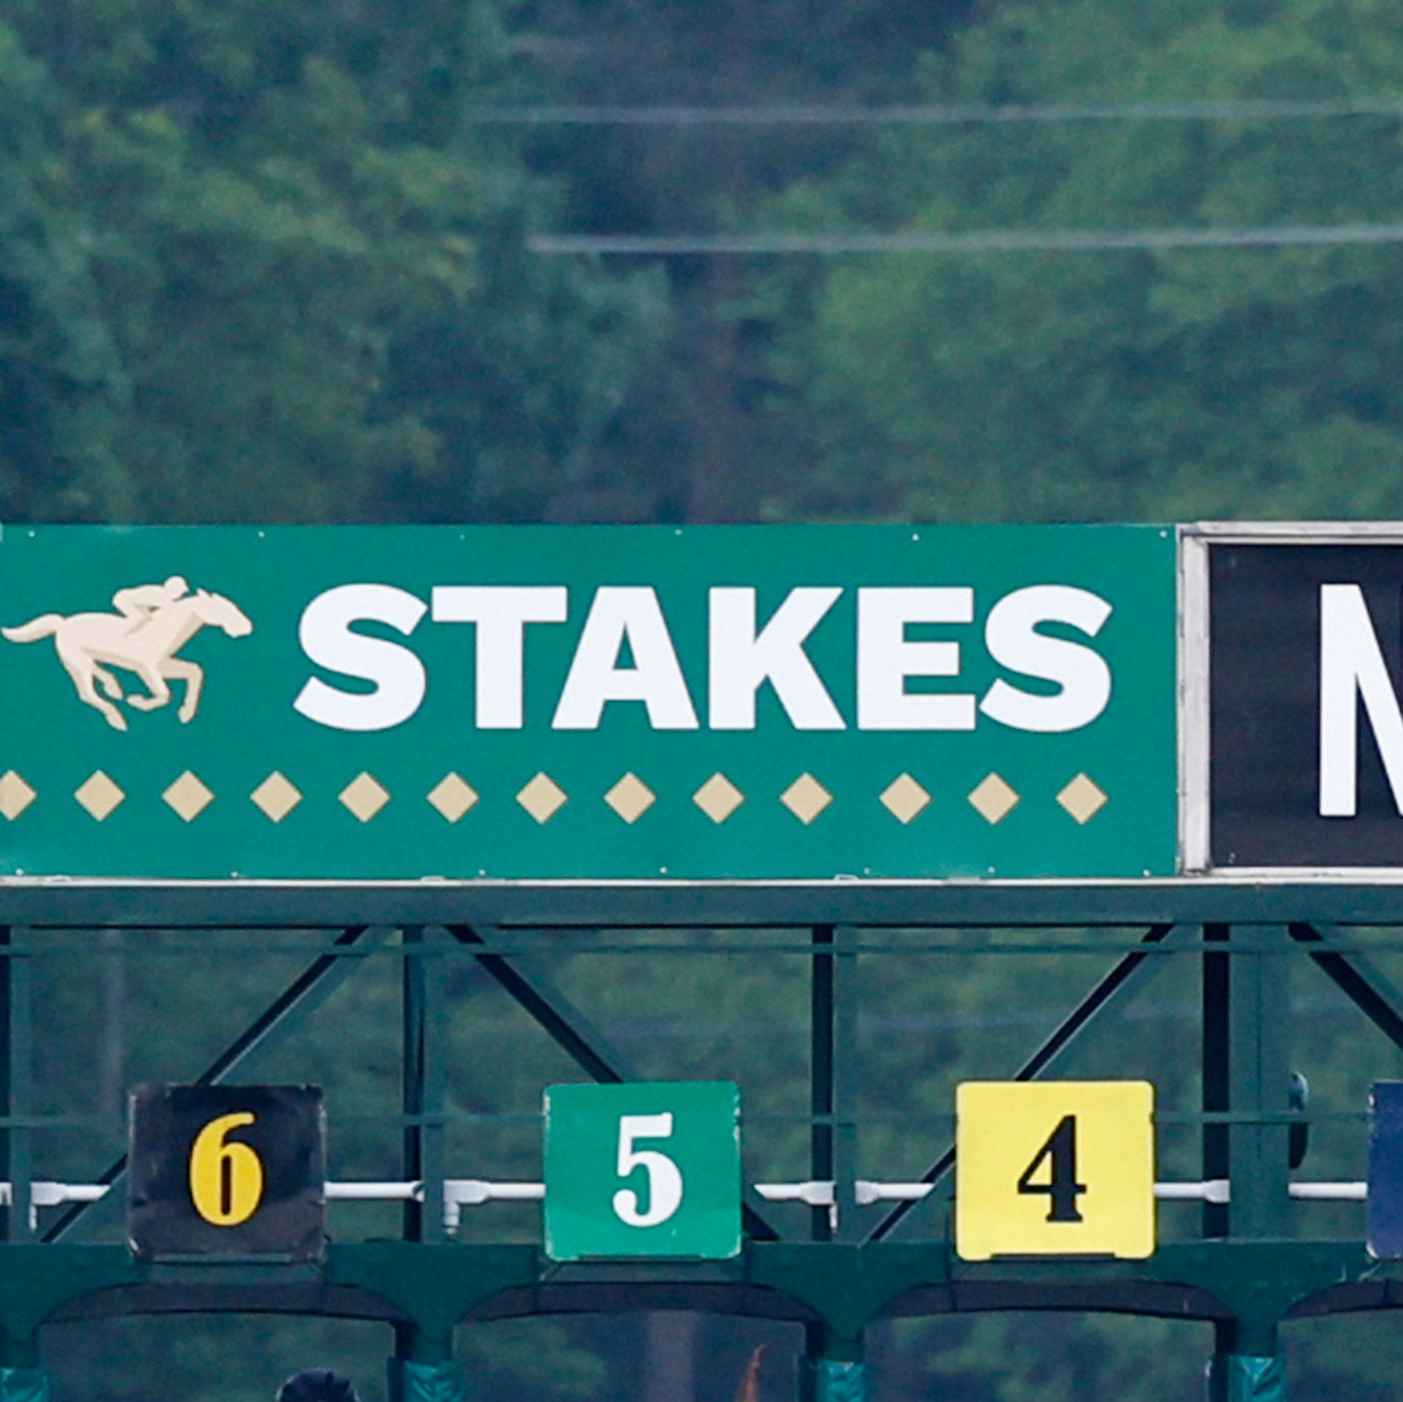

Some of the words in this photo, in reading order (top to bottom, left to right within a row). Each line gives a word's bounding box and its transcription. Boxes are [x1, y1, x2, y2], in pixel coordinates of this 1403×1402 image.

[293, 583, 1112, 732] STAKES
[190, 1113, 263, 1227] 6
[612, 1112, 683, 1228] 5
[1017, 1114, 1087, 1223] 4
